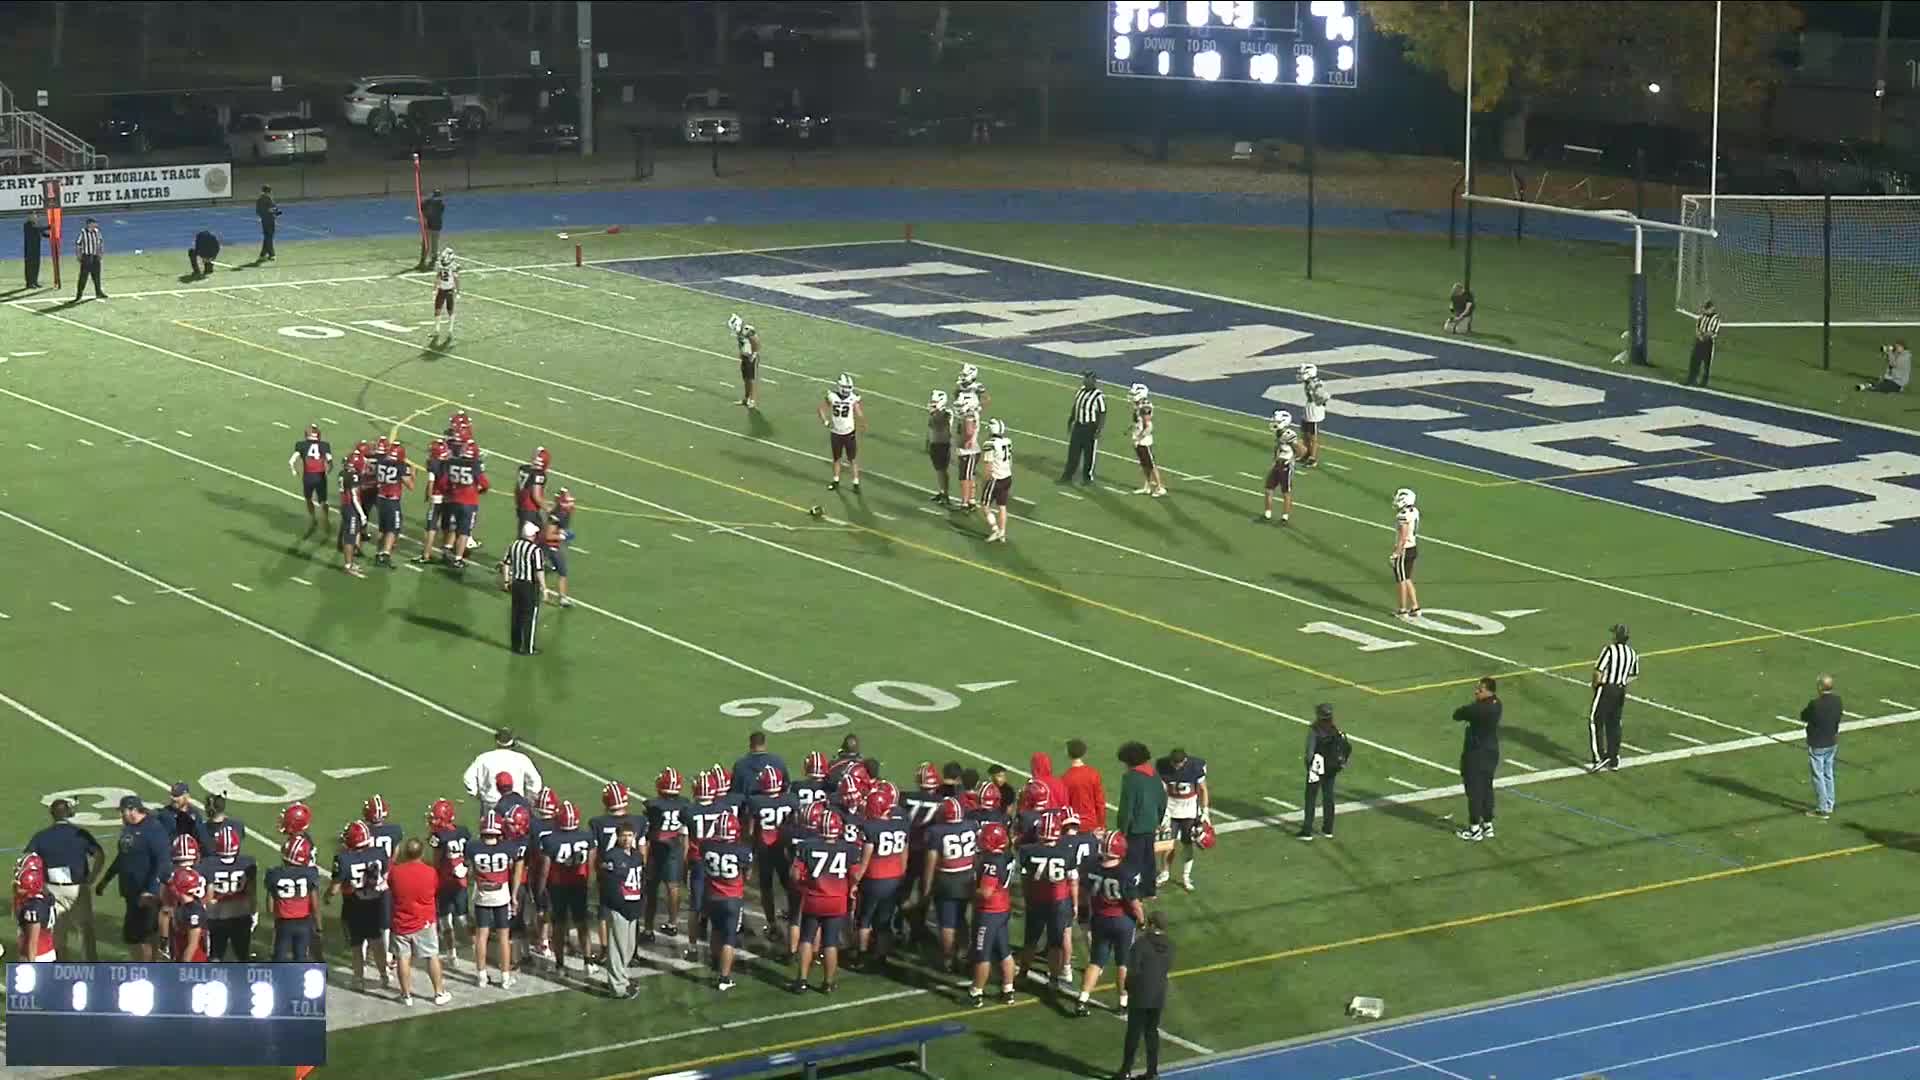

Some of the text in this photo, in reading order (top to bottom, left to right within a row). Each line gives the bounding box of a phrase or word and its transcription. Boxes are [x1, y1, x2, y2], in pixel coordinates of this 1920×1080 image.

[1144, 38, 1176, 51] DOWN
[1187, 40, 1200, 52] TO
[94, 172, 157, 185] MEMORIAL
[161, 168, 200, 181] TRACK
[64, 191, 80, 204] OF
[88, 191, 111, 203] THE
[116, 187, 170, 200] LANCERS
[307, 443, 321, 460] 4
[377, 464, 398, 484] 52
[450, 465, 474, 485] 55
[1297, 608, 1506, 651] 10
[709, 680, 961, 732] 20
[906, 799, 938, 824] 77
[877, 830, 907, 856] 68
[943, 830, 976, 859] 62
[705, 851, 739, 878] 36
[811, 852, 847, 879] 74
[983, 863, 997, 876] 72
[1030, 857, 1065, 882] 76
[277, 878, 309, 899] 31
[1088, 872, 1120, 899] 70
